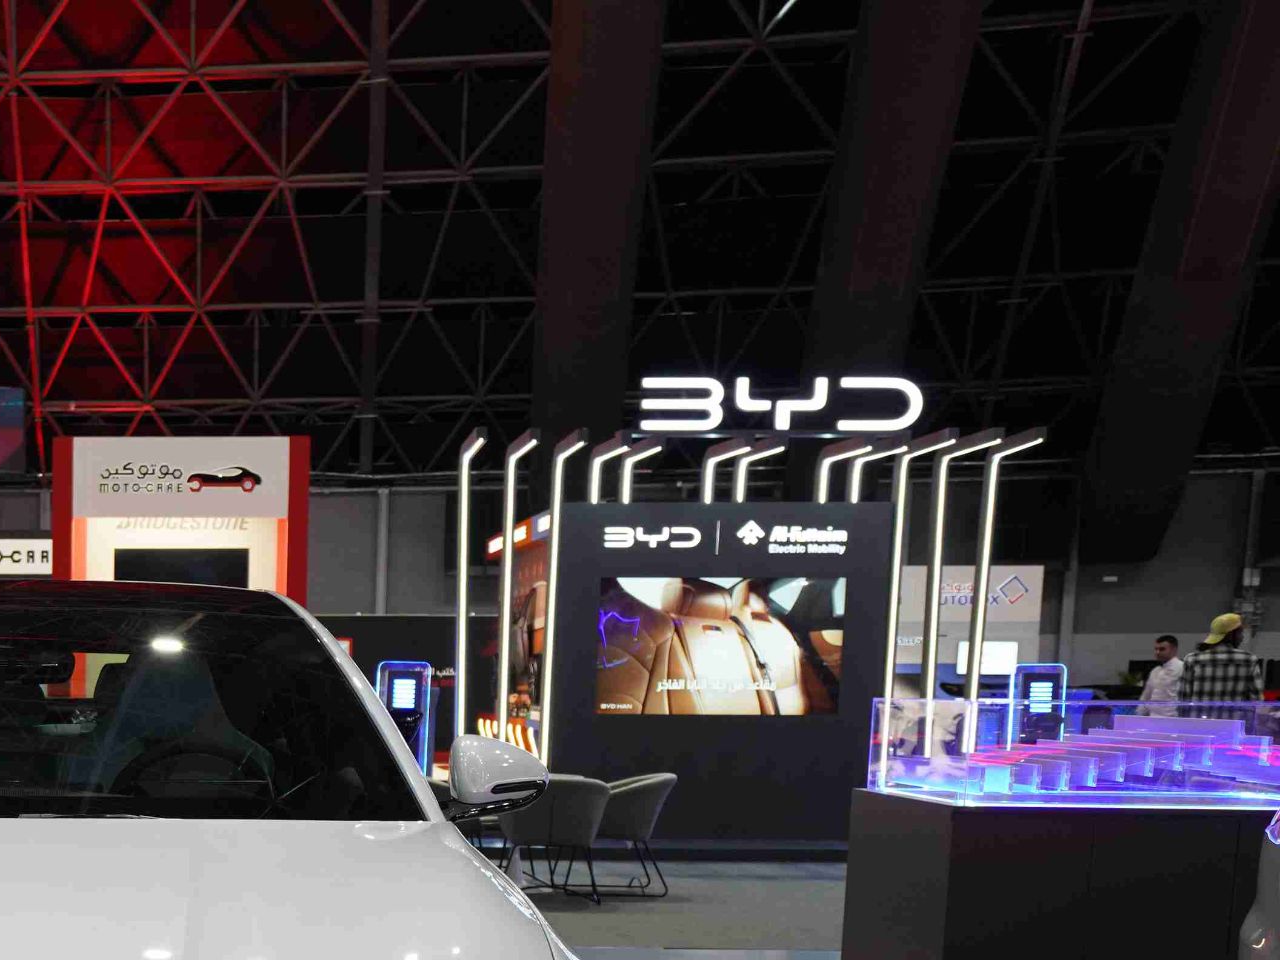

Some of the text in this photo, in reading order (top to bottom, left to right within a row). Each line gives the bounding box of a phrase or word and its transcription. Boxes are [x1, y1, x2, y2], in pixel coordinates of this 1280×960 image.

[639, 376, 924, 431] BYD
[603, 526, 702, 548] BYD
[768, 543, 846, 555] Electric Mobility
